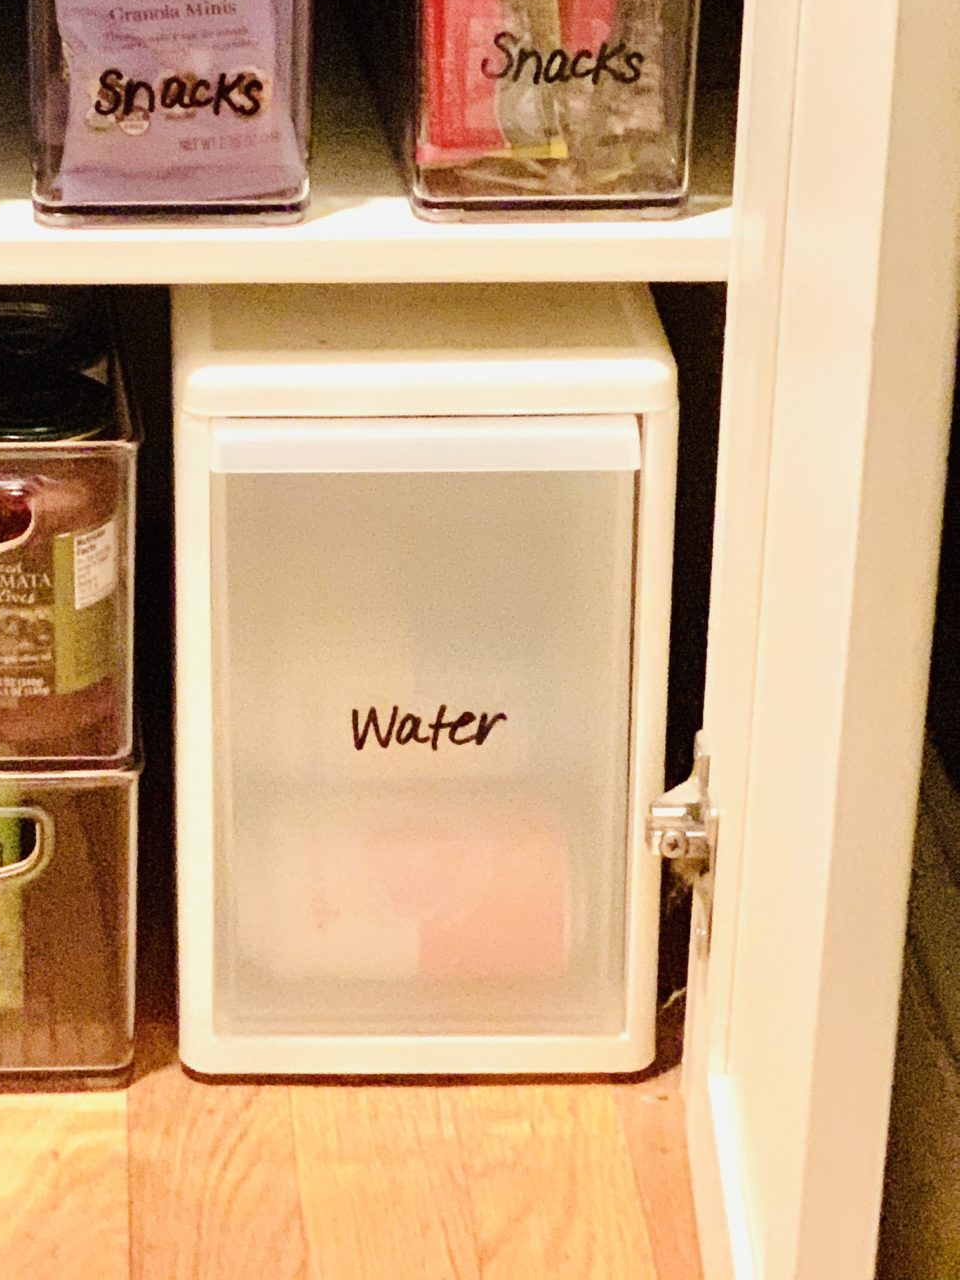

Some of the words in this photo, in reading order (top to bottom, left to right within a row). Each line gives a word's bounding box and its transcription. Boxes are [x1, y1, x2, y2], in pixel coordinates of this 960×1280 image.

[108, 2, 180, 22] Granola
[185, 0, 238, 18] Minis
[482, 31, 642, 85] Snacks
[94, 68, 264, 117] Snacks
[351, 704, 508, 752] Water
